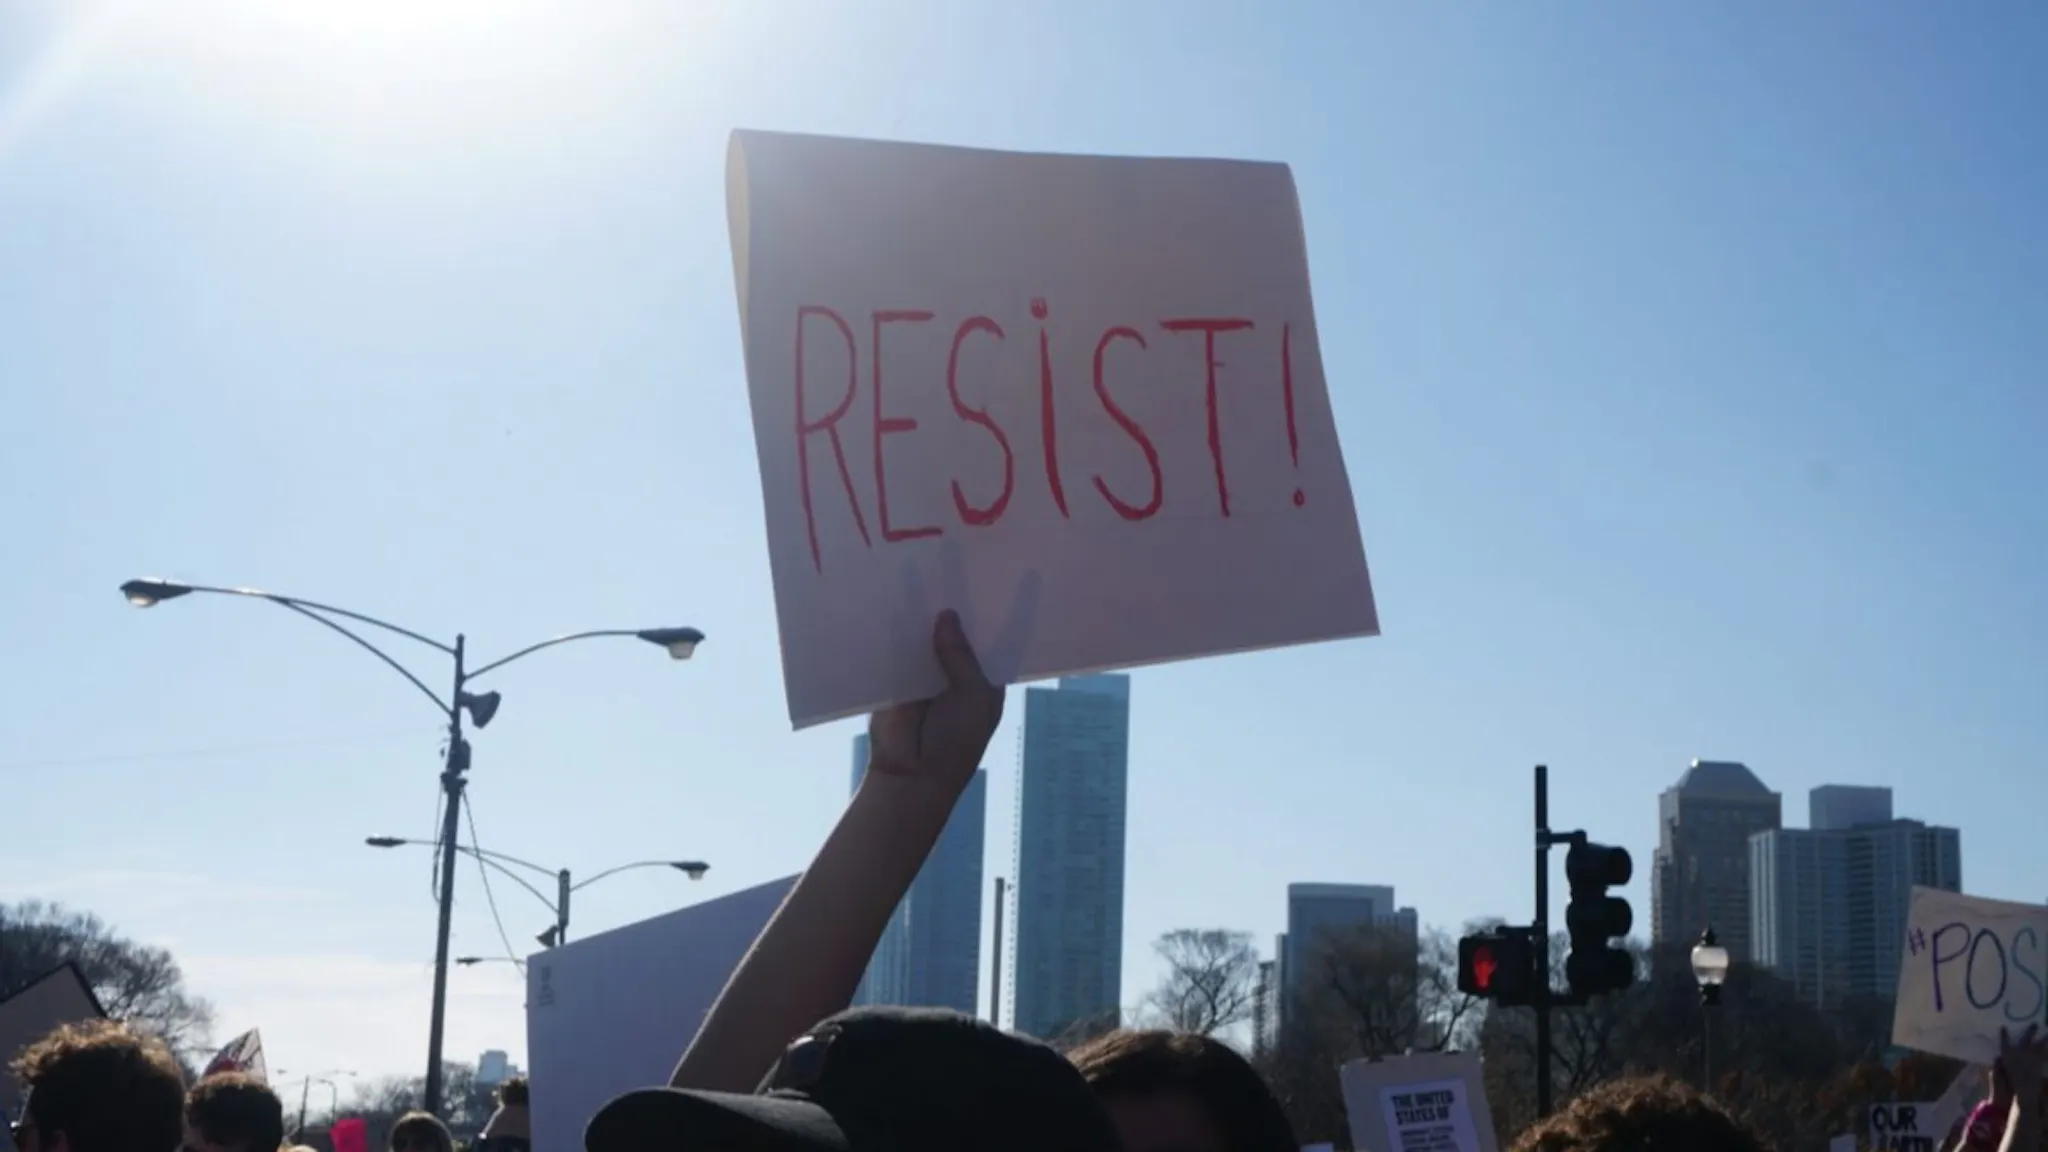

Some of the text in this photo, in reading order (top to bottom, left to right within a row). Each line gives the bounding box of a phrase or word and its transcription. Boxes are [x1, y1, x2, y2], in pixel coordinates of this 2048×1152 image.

[1908, 922, 2048, 1026] #POS
[1391, 1090, 1454, 1108] THE UNITED
[1396, 1106, 1449, 1125] STATES OF
[1873, 1105, 1918, 1132] OUR
